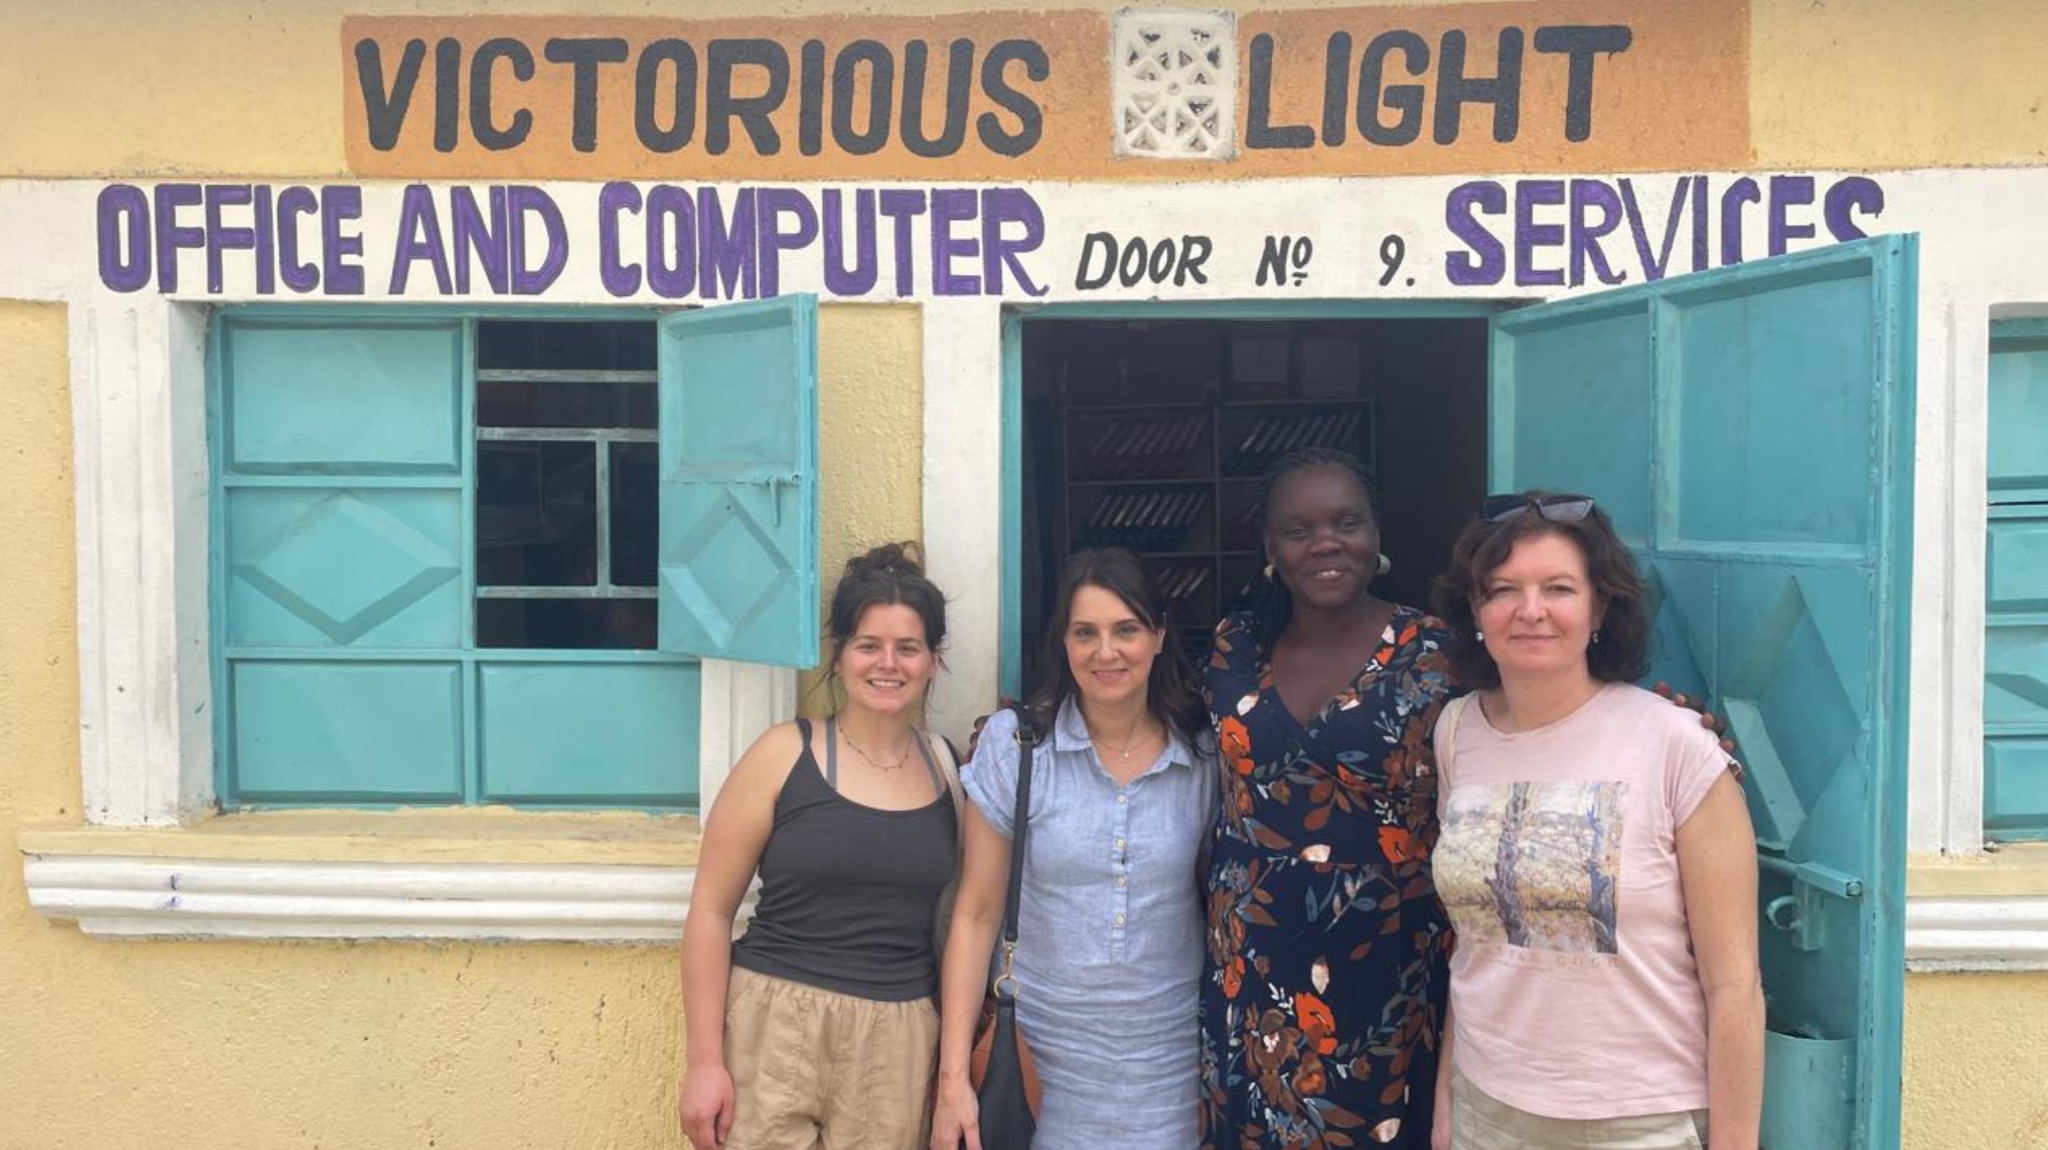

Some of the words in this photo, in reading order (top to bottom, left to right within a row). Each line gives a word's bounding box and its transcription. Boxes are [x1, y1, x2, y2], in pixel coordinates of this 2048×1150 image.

[355, 37, 1050, 158] VICTORIOUS
[1246, 24, 1633, 149] LIGHT
[97, 183, 365, 296] OFFICE
[388, 184, 569, 296] AND
[599, 181, 1050, 300] COMPUTER
[1075, 231, 1213, 290] DOOR
[1445, 175, 1885, 288] SERVICES
